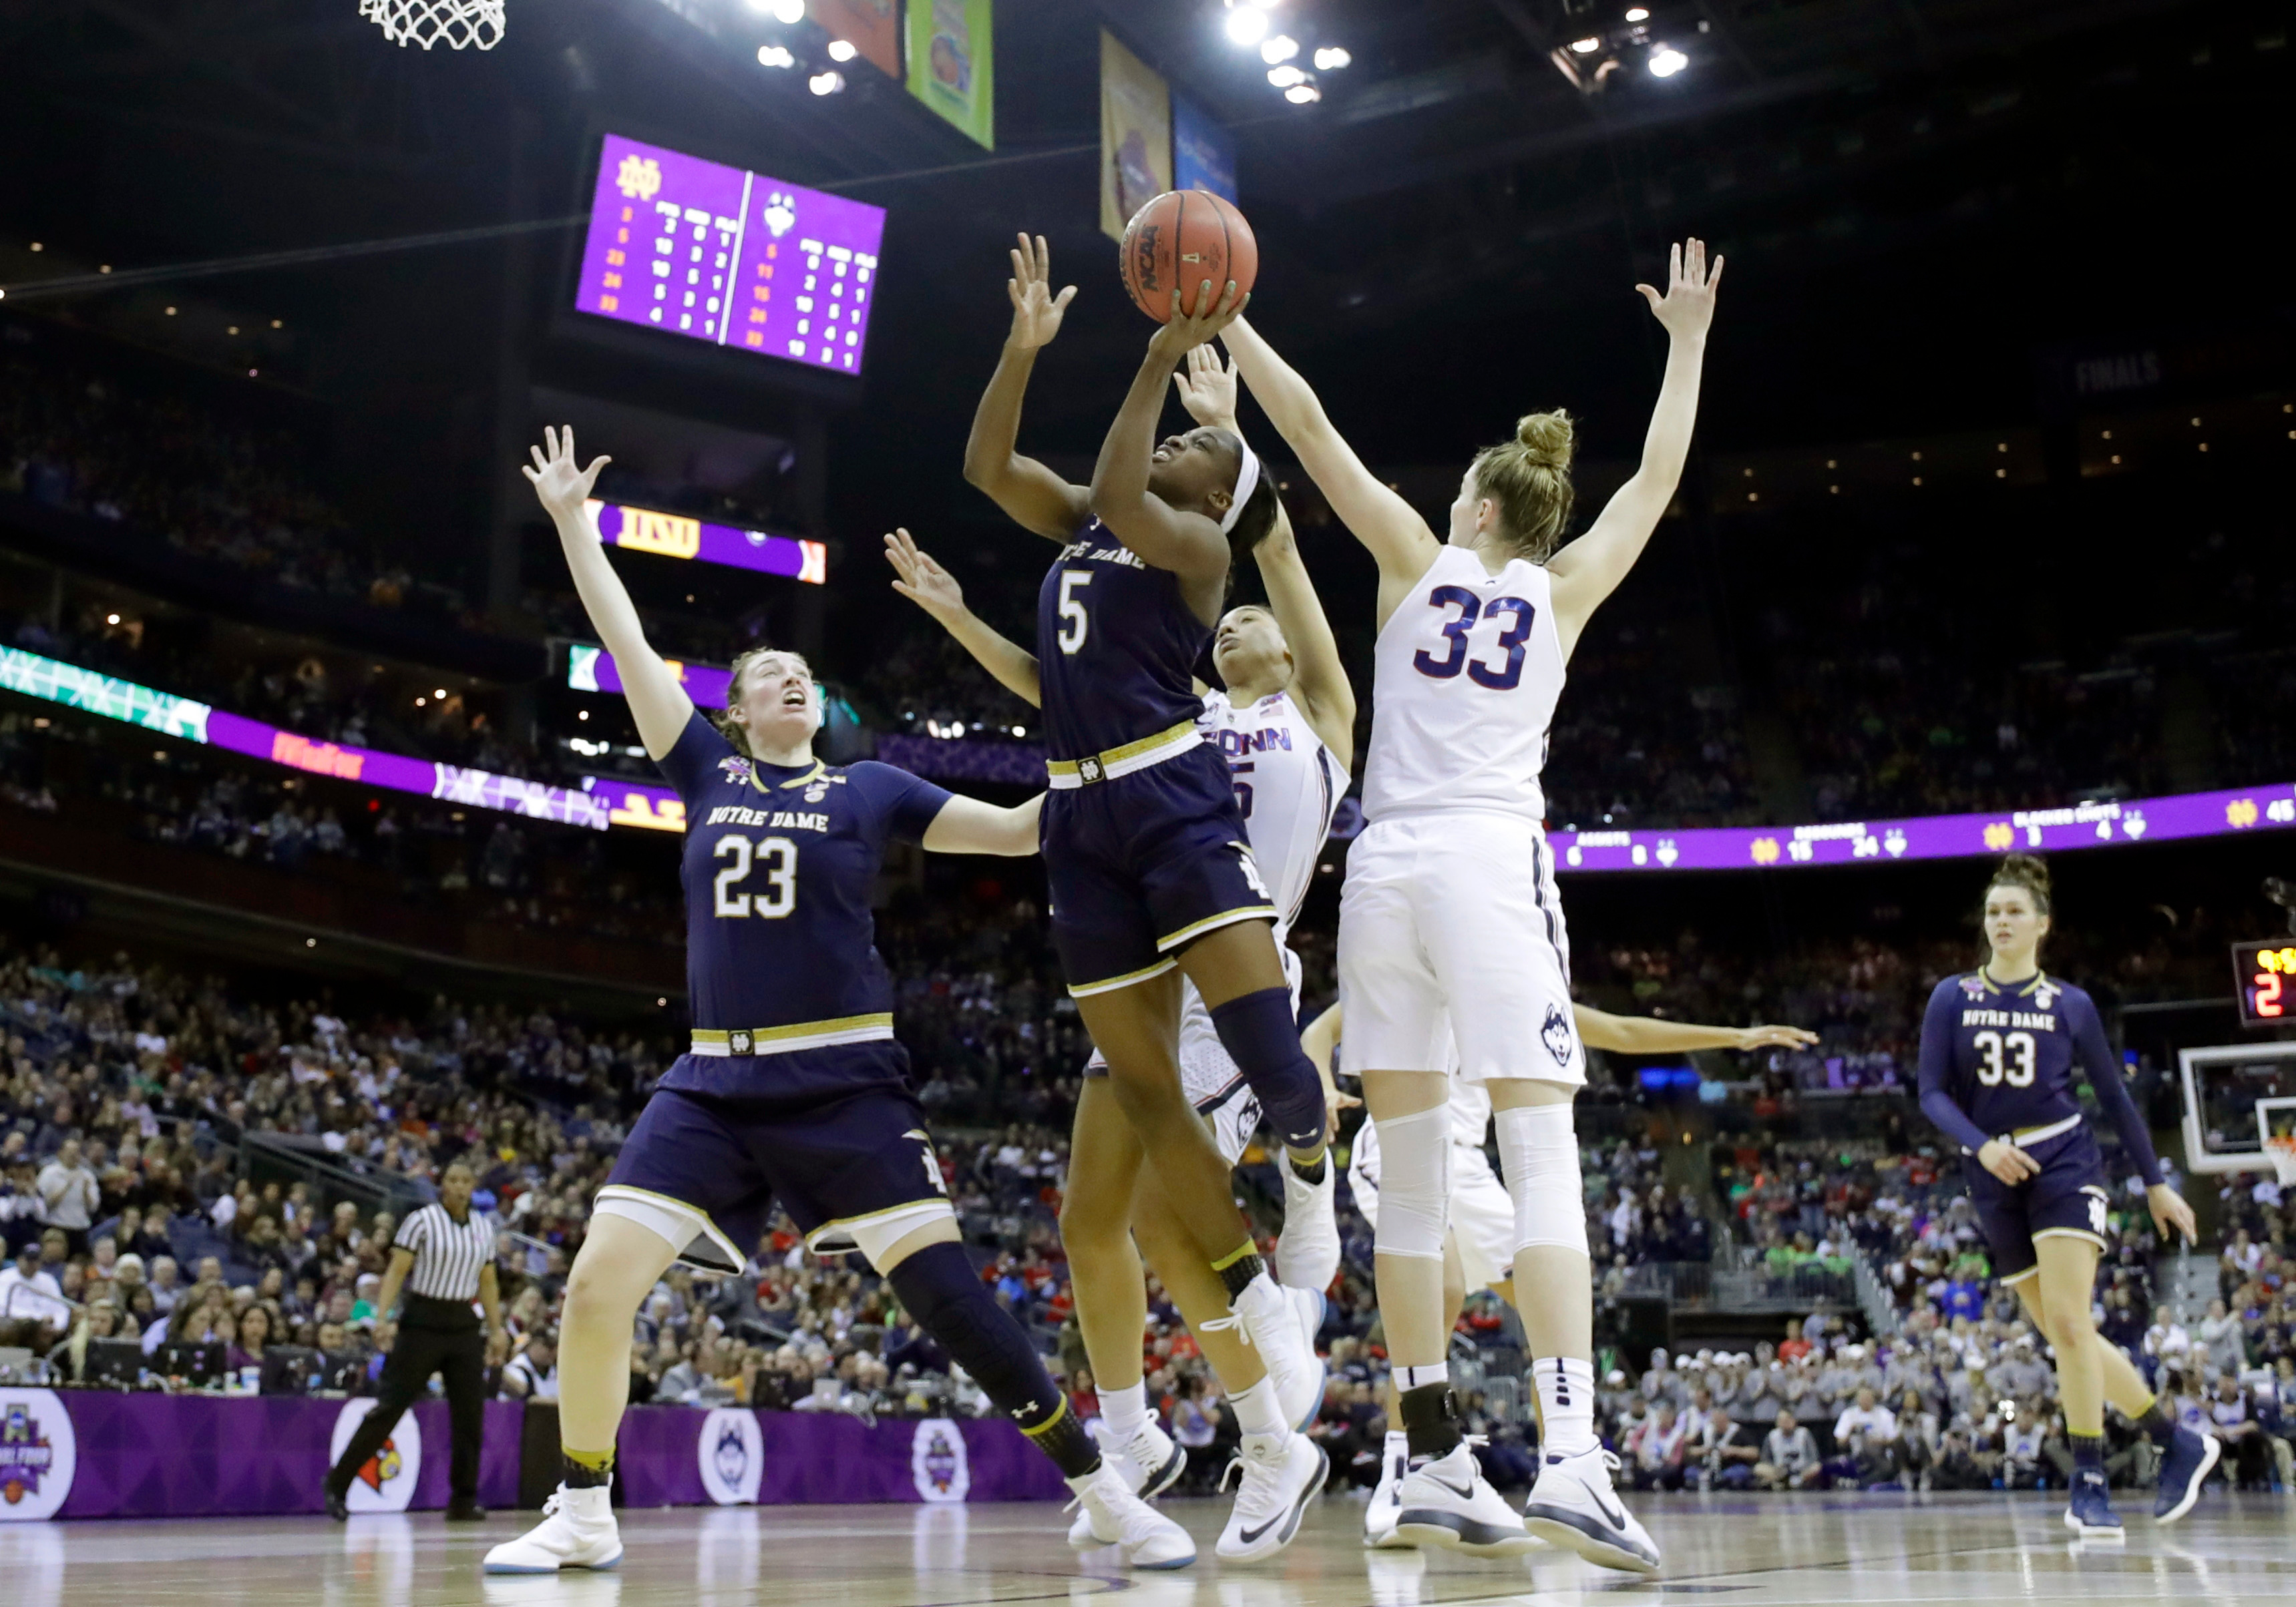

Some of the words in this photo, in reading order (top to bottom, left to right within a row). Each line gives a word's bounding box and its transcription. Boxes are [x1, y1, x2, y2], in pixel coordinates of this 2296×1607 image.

[1139, 224, 1159, 292] NCAA
[1058, 569, 1095, 655] 5
[1413, 585, 1535, 690] 33
[707, 806, 768, 826] NOTRE
[769, 811, 829, 833] DAME
[713, 834, 798, 919] 23
[1962, 1009, 2008, 1027] NOTRE
[2012, 1011, 2056, 1032] DAME
[1973, 1031, 2036, 1088] 33
